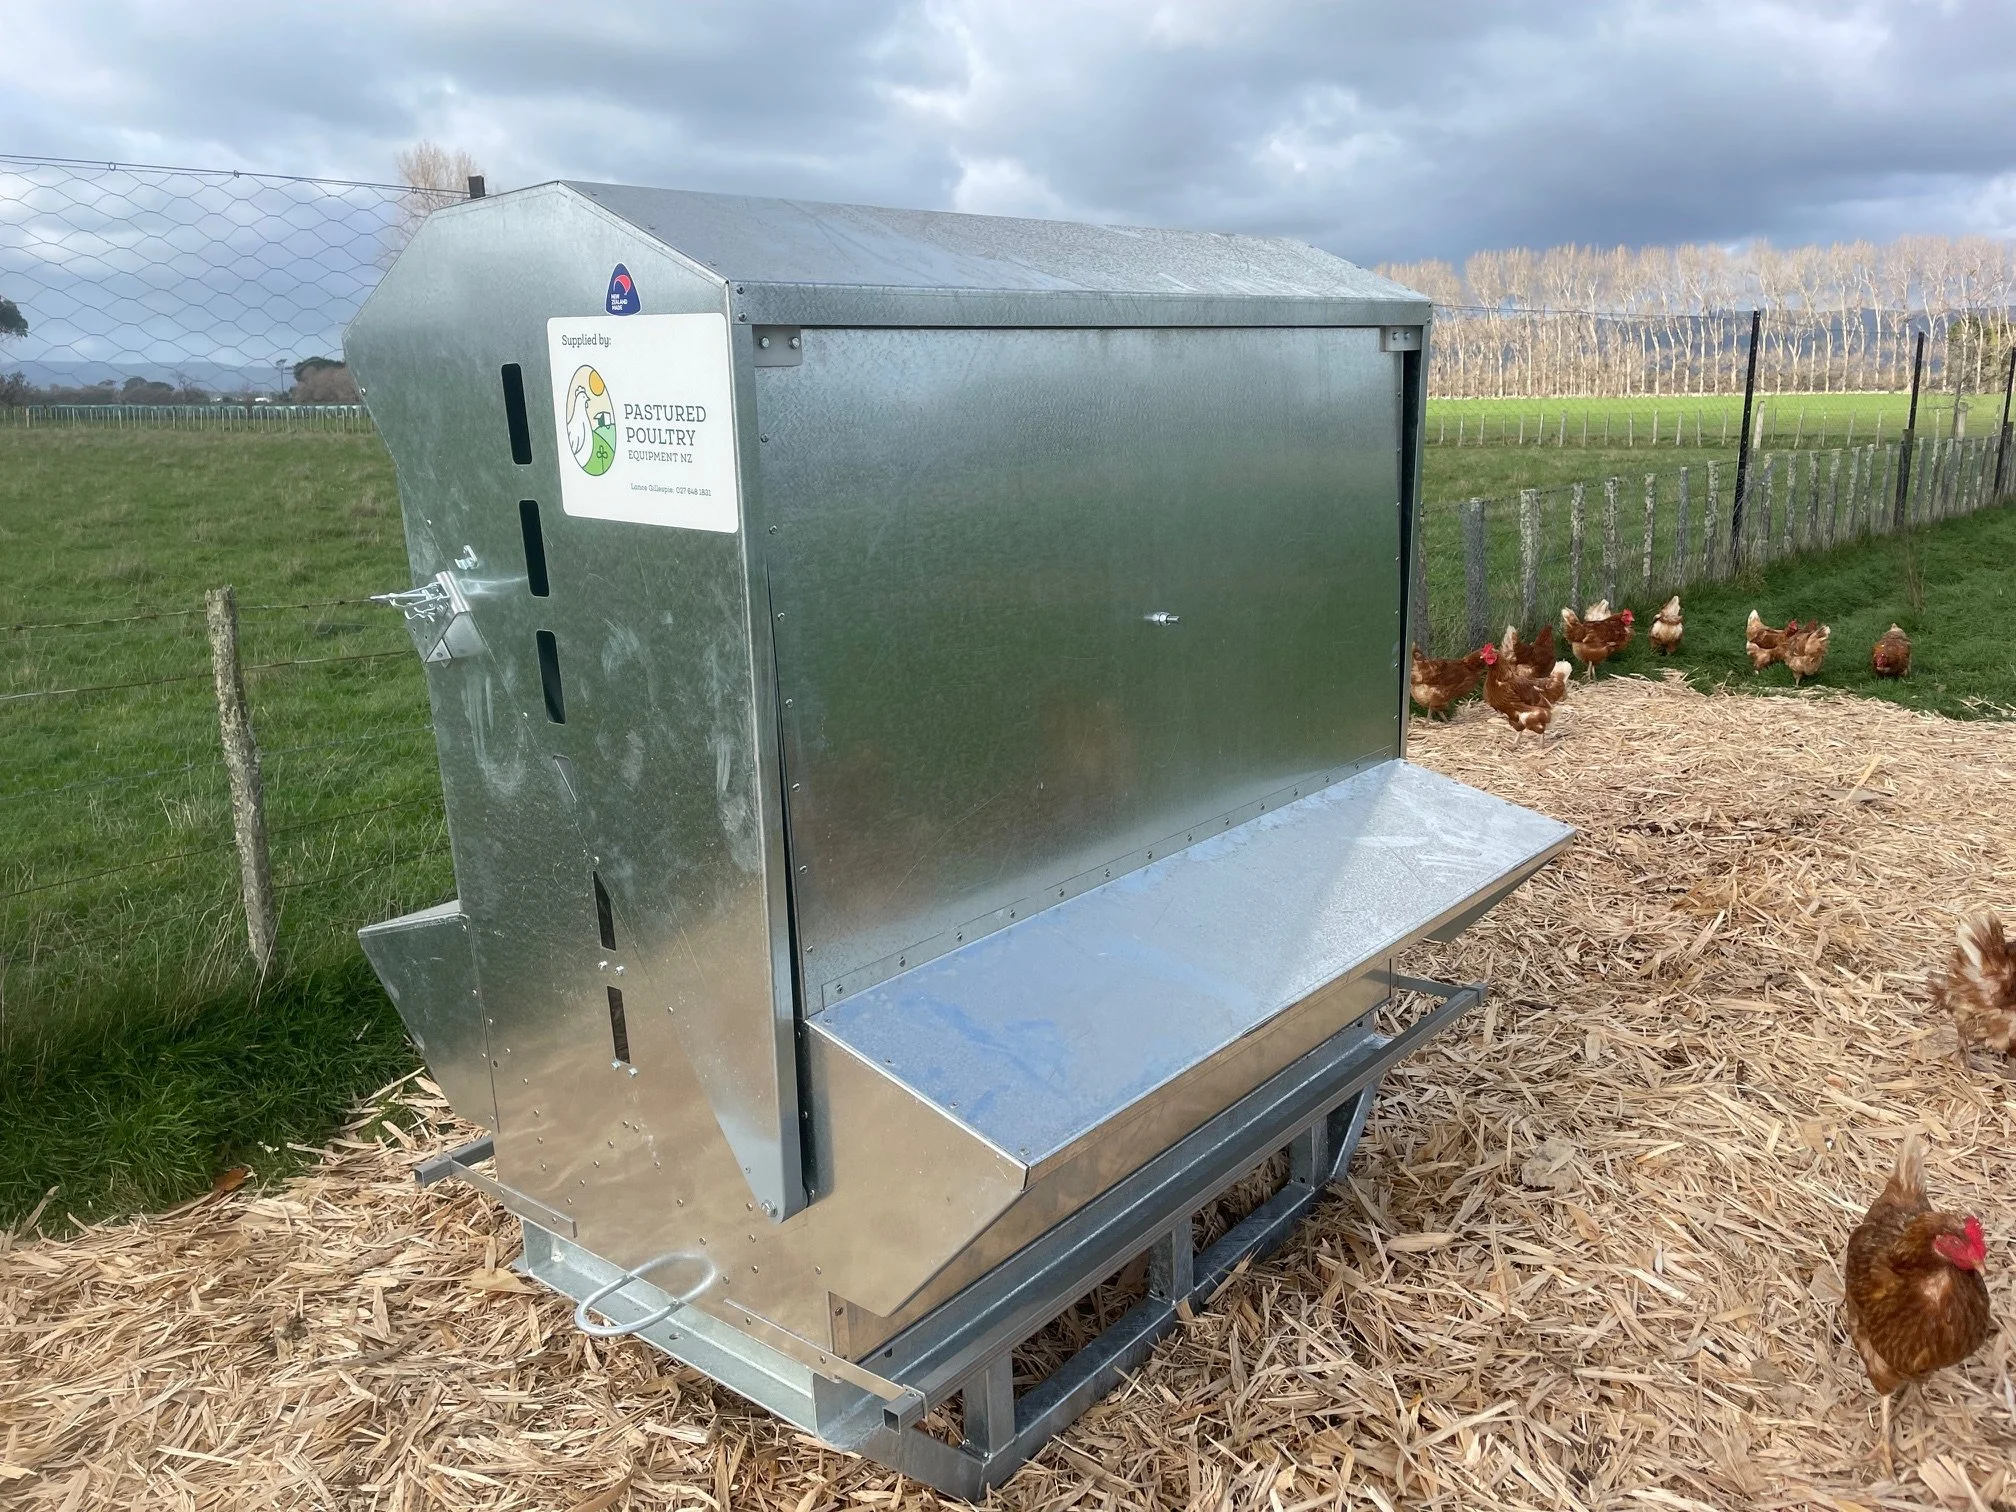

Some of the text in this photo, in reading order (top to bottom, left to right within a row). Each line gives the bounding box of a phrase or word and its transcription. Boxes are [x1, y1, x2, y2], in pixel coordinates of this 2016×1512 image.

[561, 333, 612, 348] Supplied by:
[624, 403, 707, 423] PASTURED
[625, 426, 696, 446] POULTRY
[628, 449, 693, 464] EQUIPMENT NZ
[630, 482, 648, 491] Lance
[675, 486, 687, 495] 027
